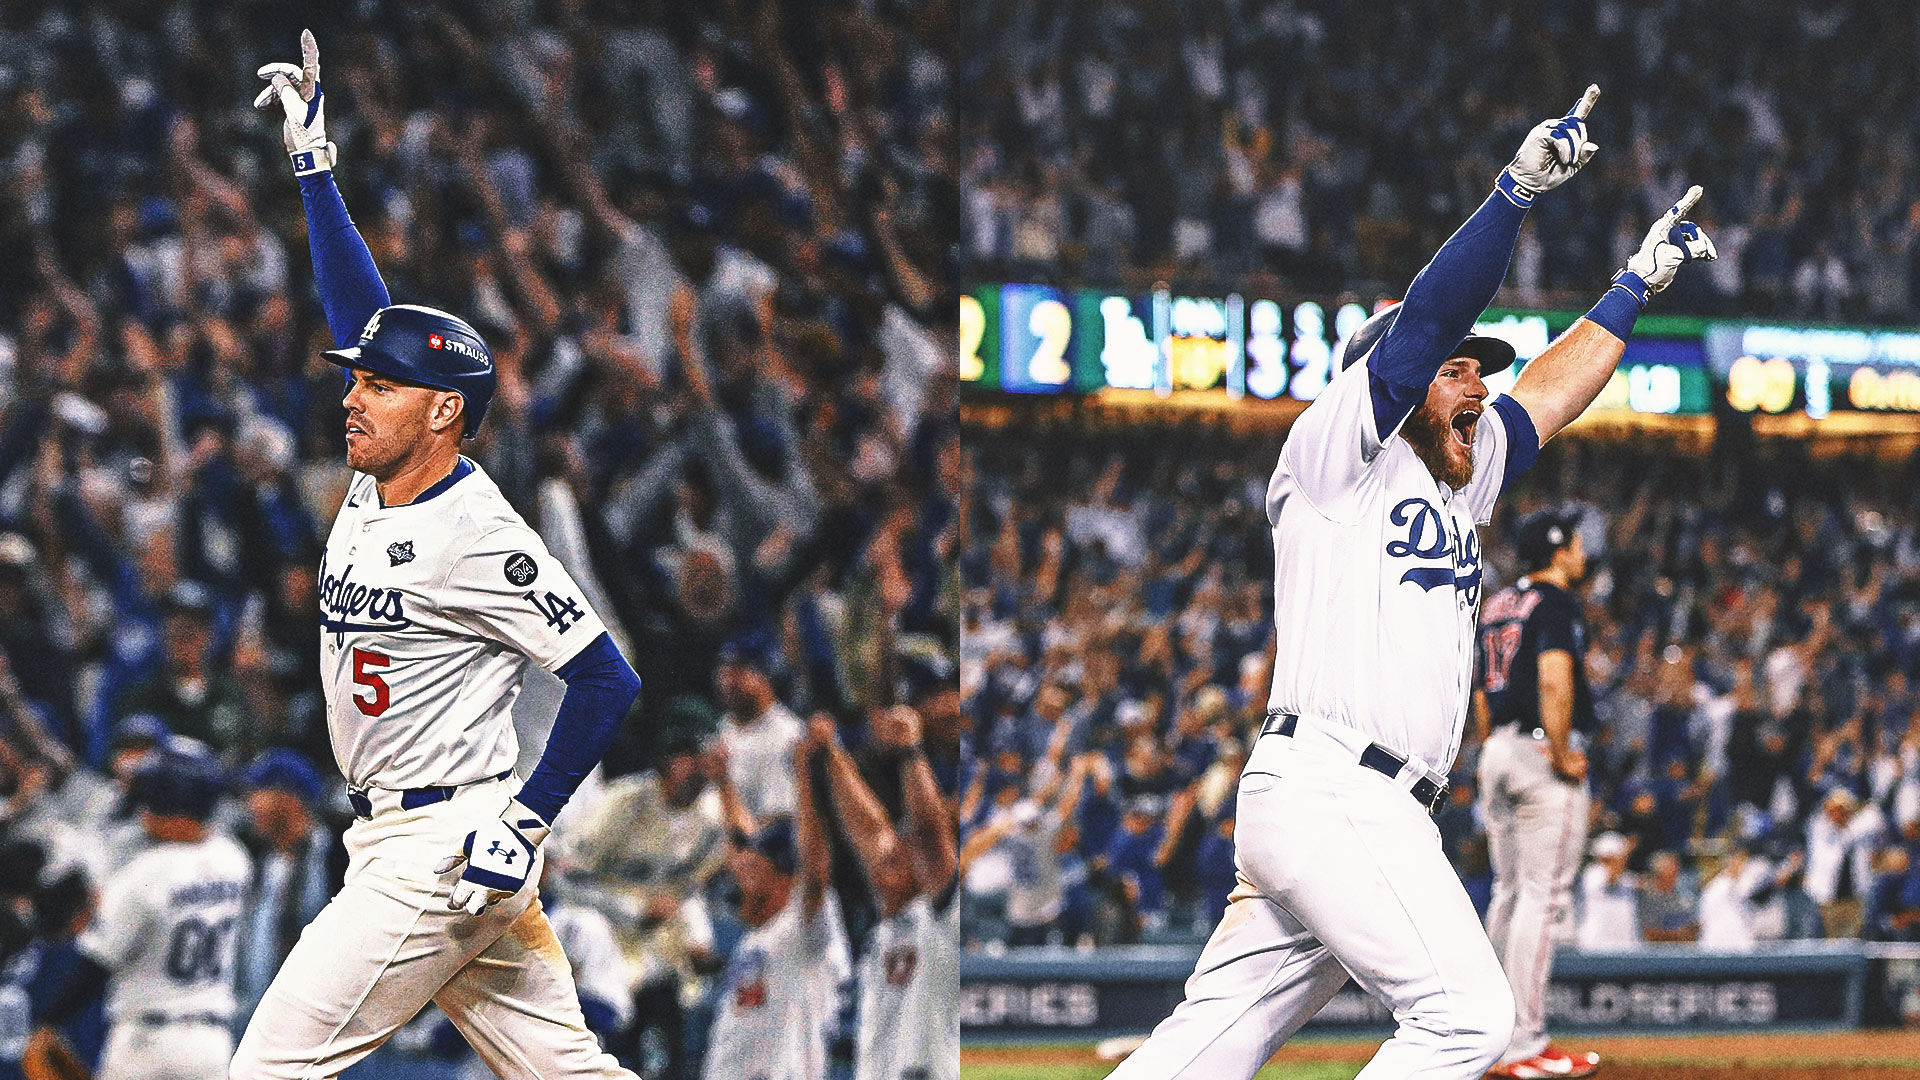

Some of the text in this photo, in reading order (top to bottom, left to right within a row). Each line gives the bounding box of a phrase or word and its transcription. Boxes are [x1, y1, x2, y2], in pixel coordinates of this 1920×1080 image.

[297, 156, 306, 169] 5
[445, 339, 489, 367] STRAUSS
[1028, 300, 1071, 385] 2
[512, 561, 535, 583] 34
[319, 545, 404, 651] odgers
[523, 590, 585, 635] LA
[352, 646, 390, 718] 5
[960, 985, 1098, 1026] ERIES
[1630, 981, 1778, 1024] SERIES
